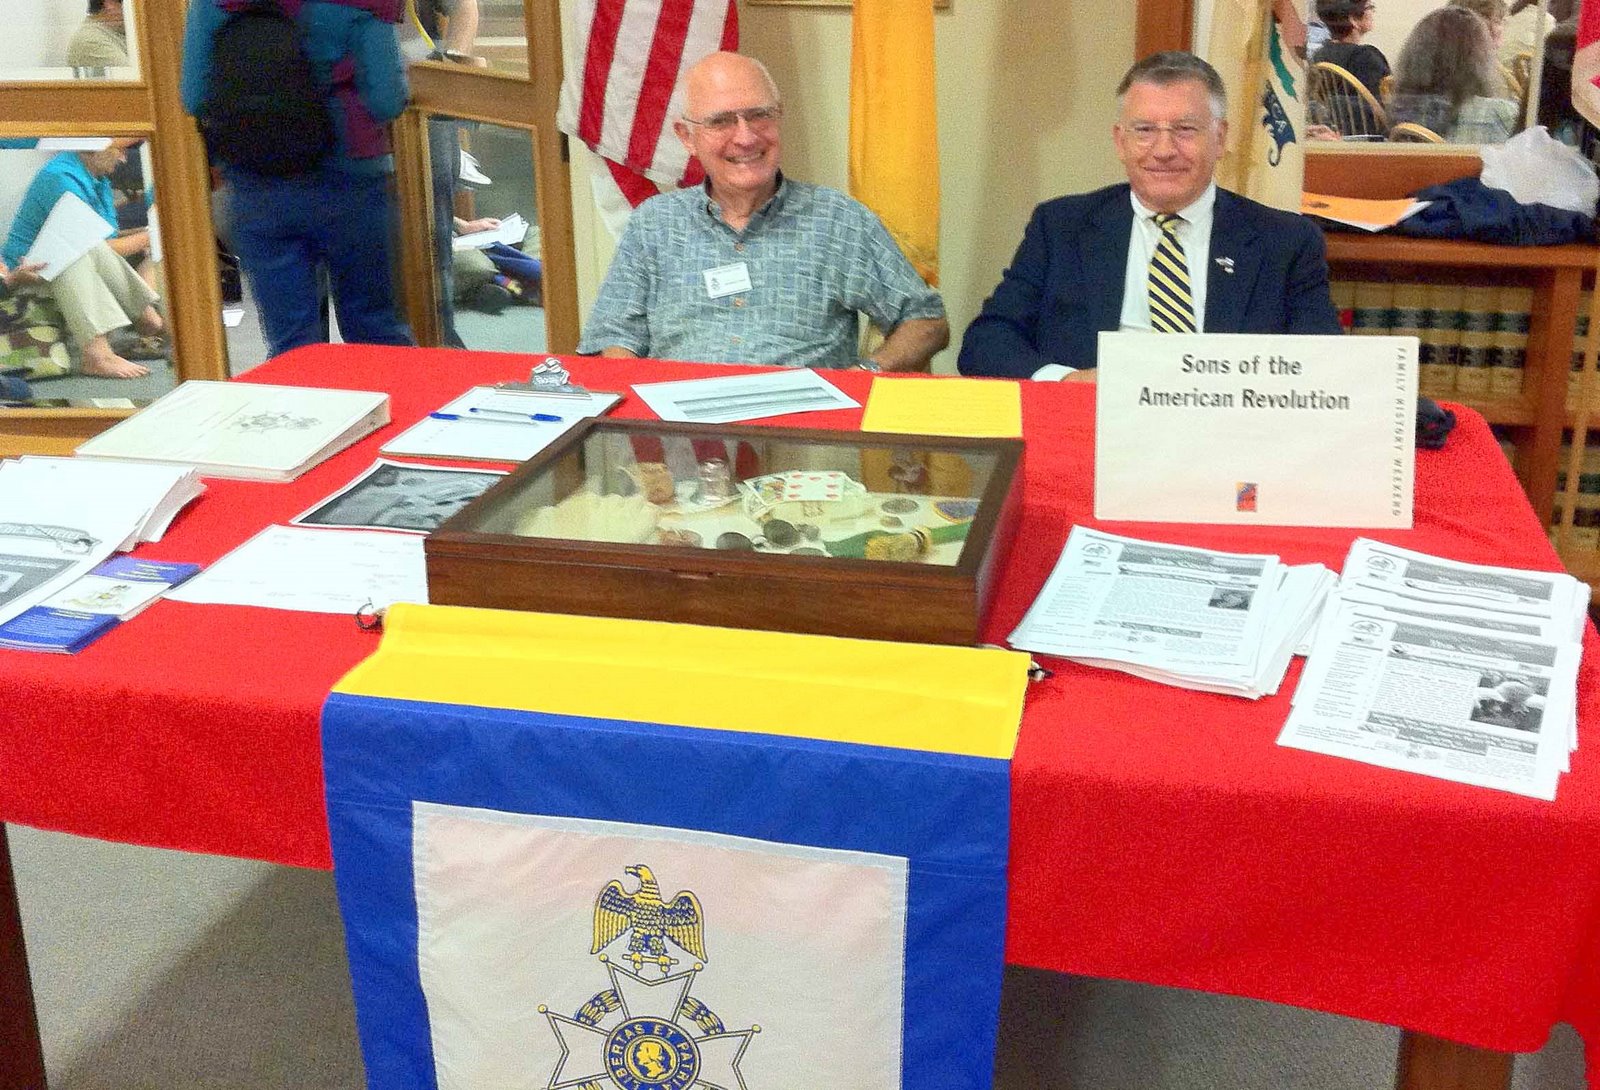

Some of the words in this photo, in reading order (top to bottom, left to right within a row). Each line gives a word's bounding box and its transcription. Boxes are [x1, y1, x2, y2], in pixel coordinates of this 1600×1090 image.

[1181, 353, 1231, 375] Sons
[1238, 355, 1261, 375] of
[1268, 355, 1303, 376] the
[1396, 347, 1407, 392] FAMILY
[1139, 386, 1234, 408] American
[1242, 388, 1351, 410] Revolution
[1394, 398, 1405, 451] HISTORY
[653, 1024, 675, 1038] ET
